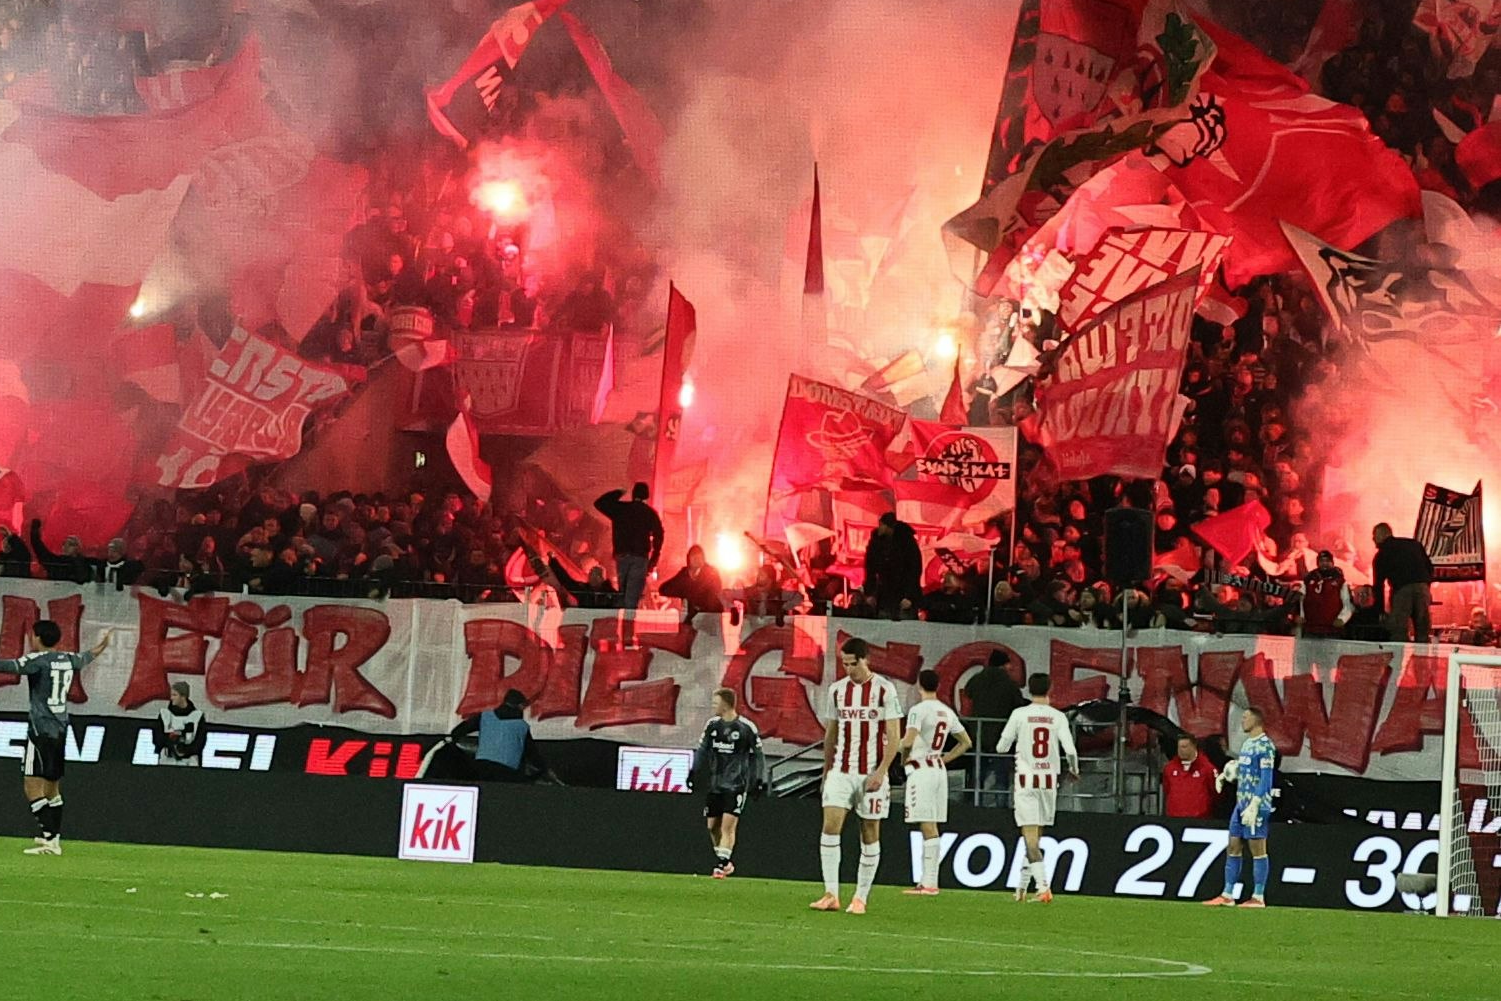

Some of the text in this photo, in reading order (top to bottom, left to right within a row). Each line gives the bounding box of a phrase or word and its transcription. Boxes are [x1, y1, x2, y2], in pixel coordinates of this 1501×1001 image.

[120, 592, 397, 719] FÜR
[456, 615, 698, 731] DIE
[47, 669, 74, 706] 18
[931, 720, 947, 751] 6
[1031, 727, 1050, 759] 8
[868, 798, 883, 815] 16
[409, 800, 467, 853] kik
